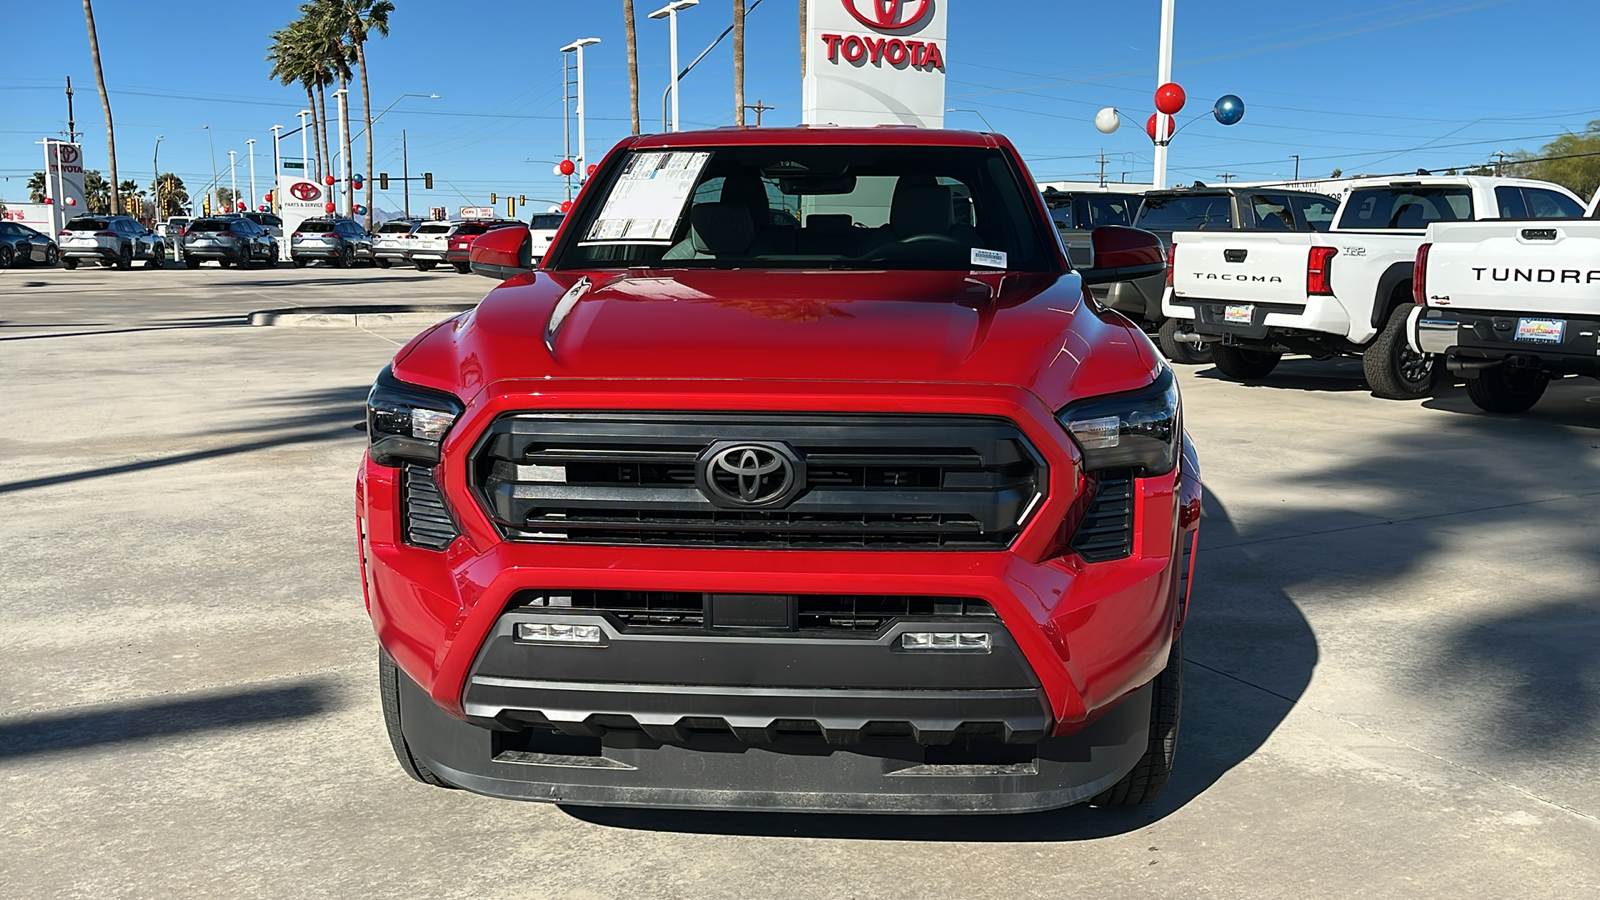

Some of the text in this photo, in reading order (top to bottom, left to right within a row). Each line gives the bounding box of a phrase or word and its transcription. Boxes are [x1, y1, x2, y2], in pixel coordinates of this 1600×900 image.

[821, 33, 943, 68] TOYOTA
[1192, 272, 1283, 283] TACOMA
[1471, 267, 1600, 284] TUNDRA
